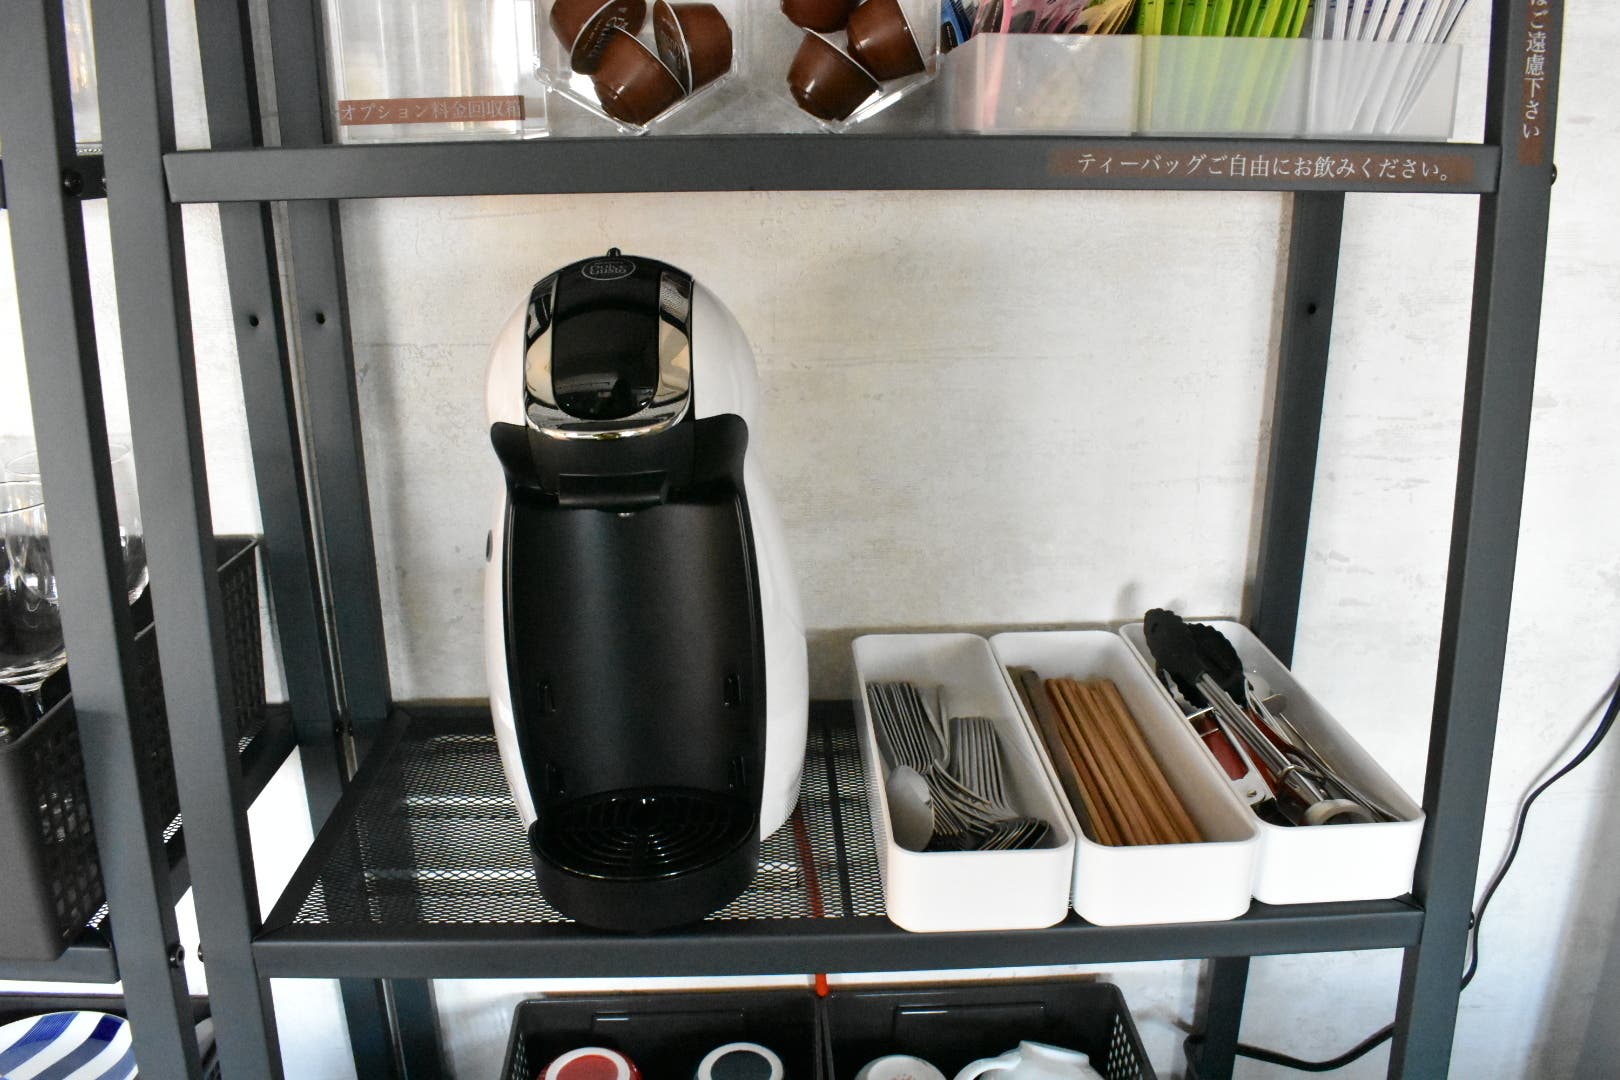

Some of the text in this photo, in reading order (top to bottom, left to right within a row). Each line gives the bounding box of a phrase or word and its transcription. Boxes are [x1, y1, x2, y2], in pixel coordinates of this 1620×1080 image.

[1077, 153, 1449, 182] ティーバッグご自由にお飲みください。
